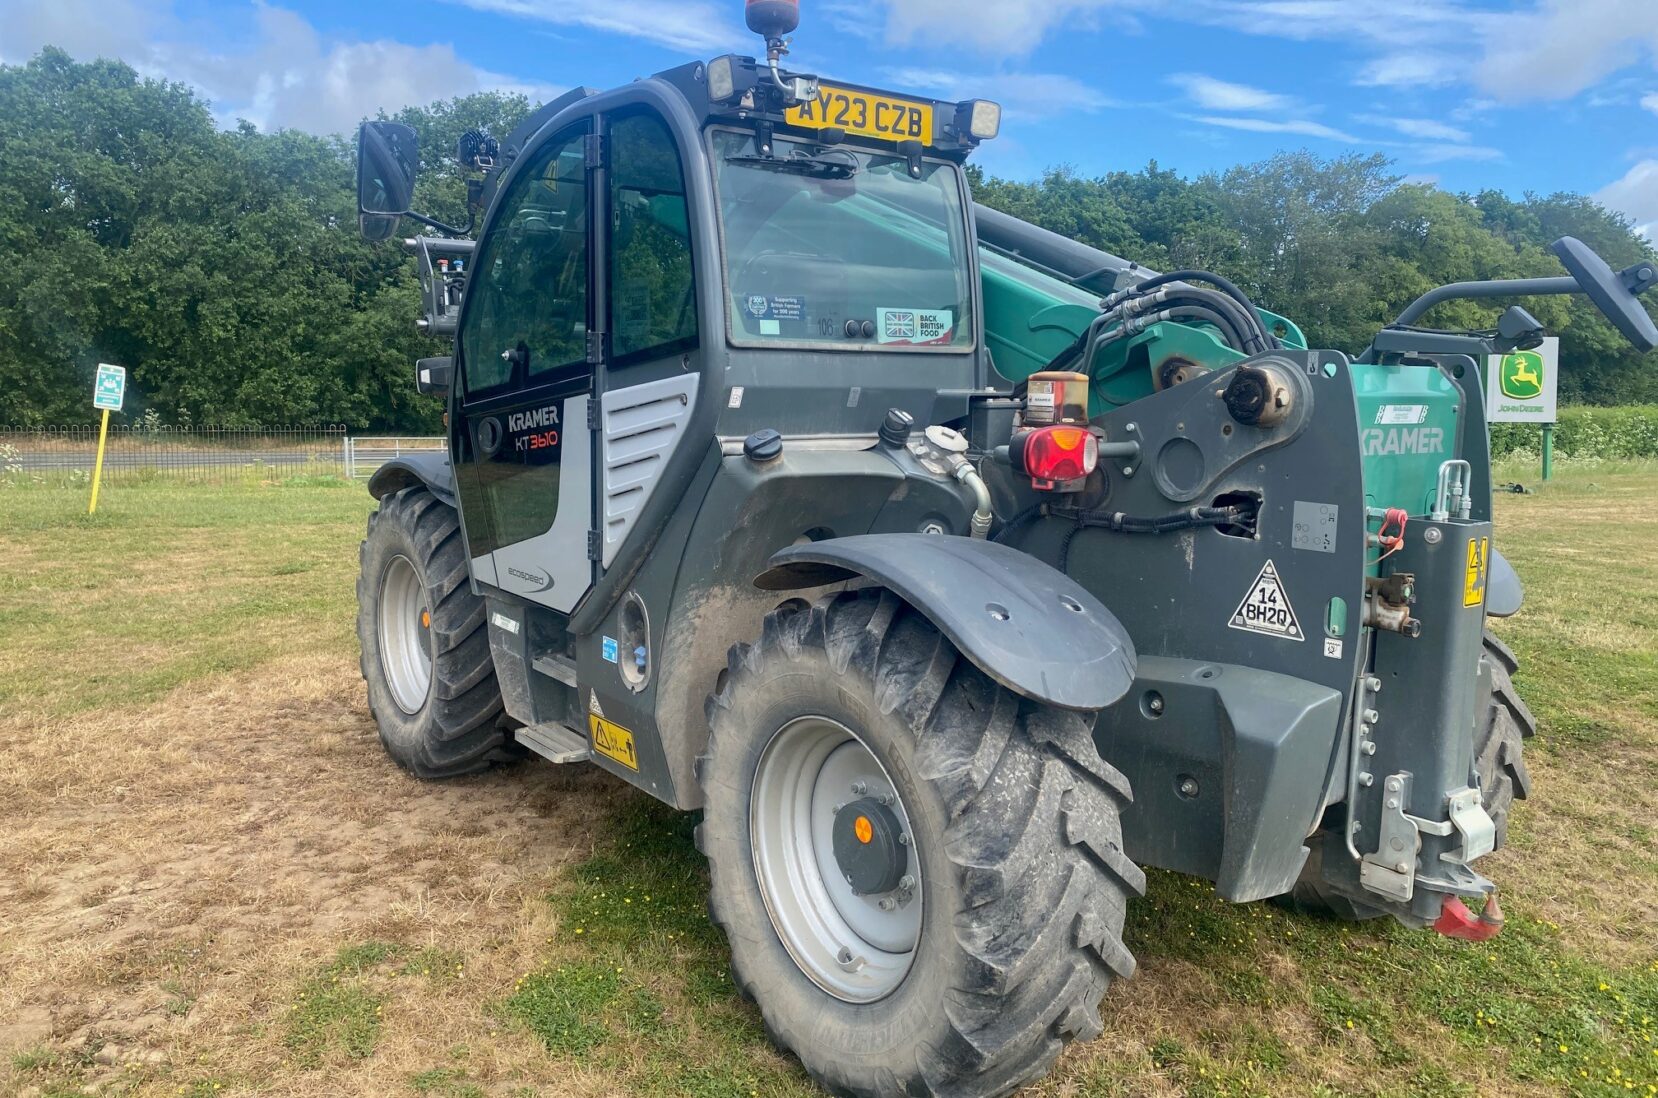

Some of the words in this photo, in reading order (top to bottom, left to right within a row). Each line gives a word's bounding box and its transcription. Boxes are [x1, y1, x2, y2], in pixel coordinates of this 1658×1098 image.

[798, 93, 867, 129] AY23
[875, 101, 922, 138] CZB
[920, 322, 945, 330] BRITISH
[920, 329, 939, 337] FOOD
[508, 405, 559, 433] KRAMER
[508, 567, 544, 585] ecospeed
[1258, 587, 1277, 606] 14
[1246, 603, 1287, 627] BH2Q
